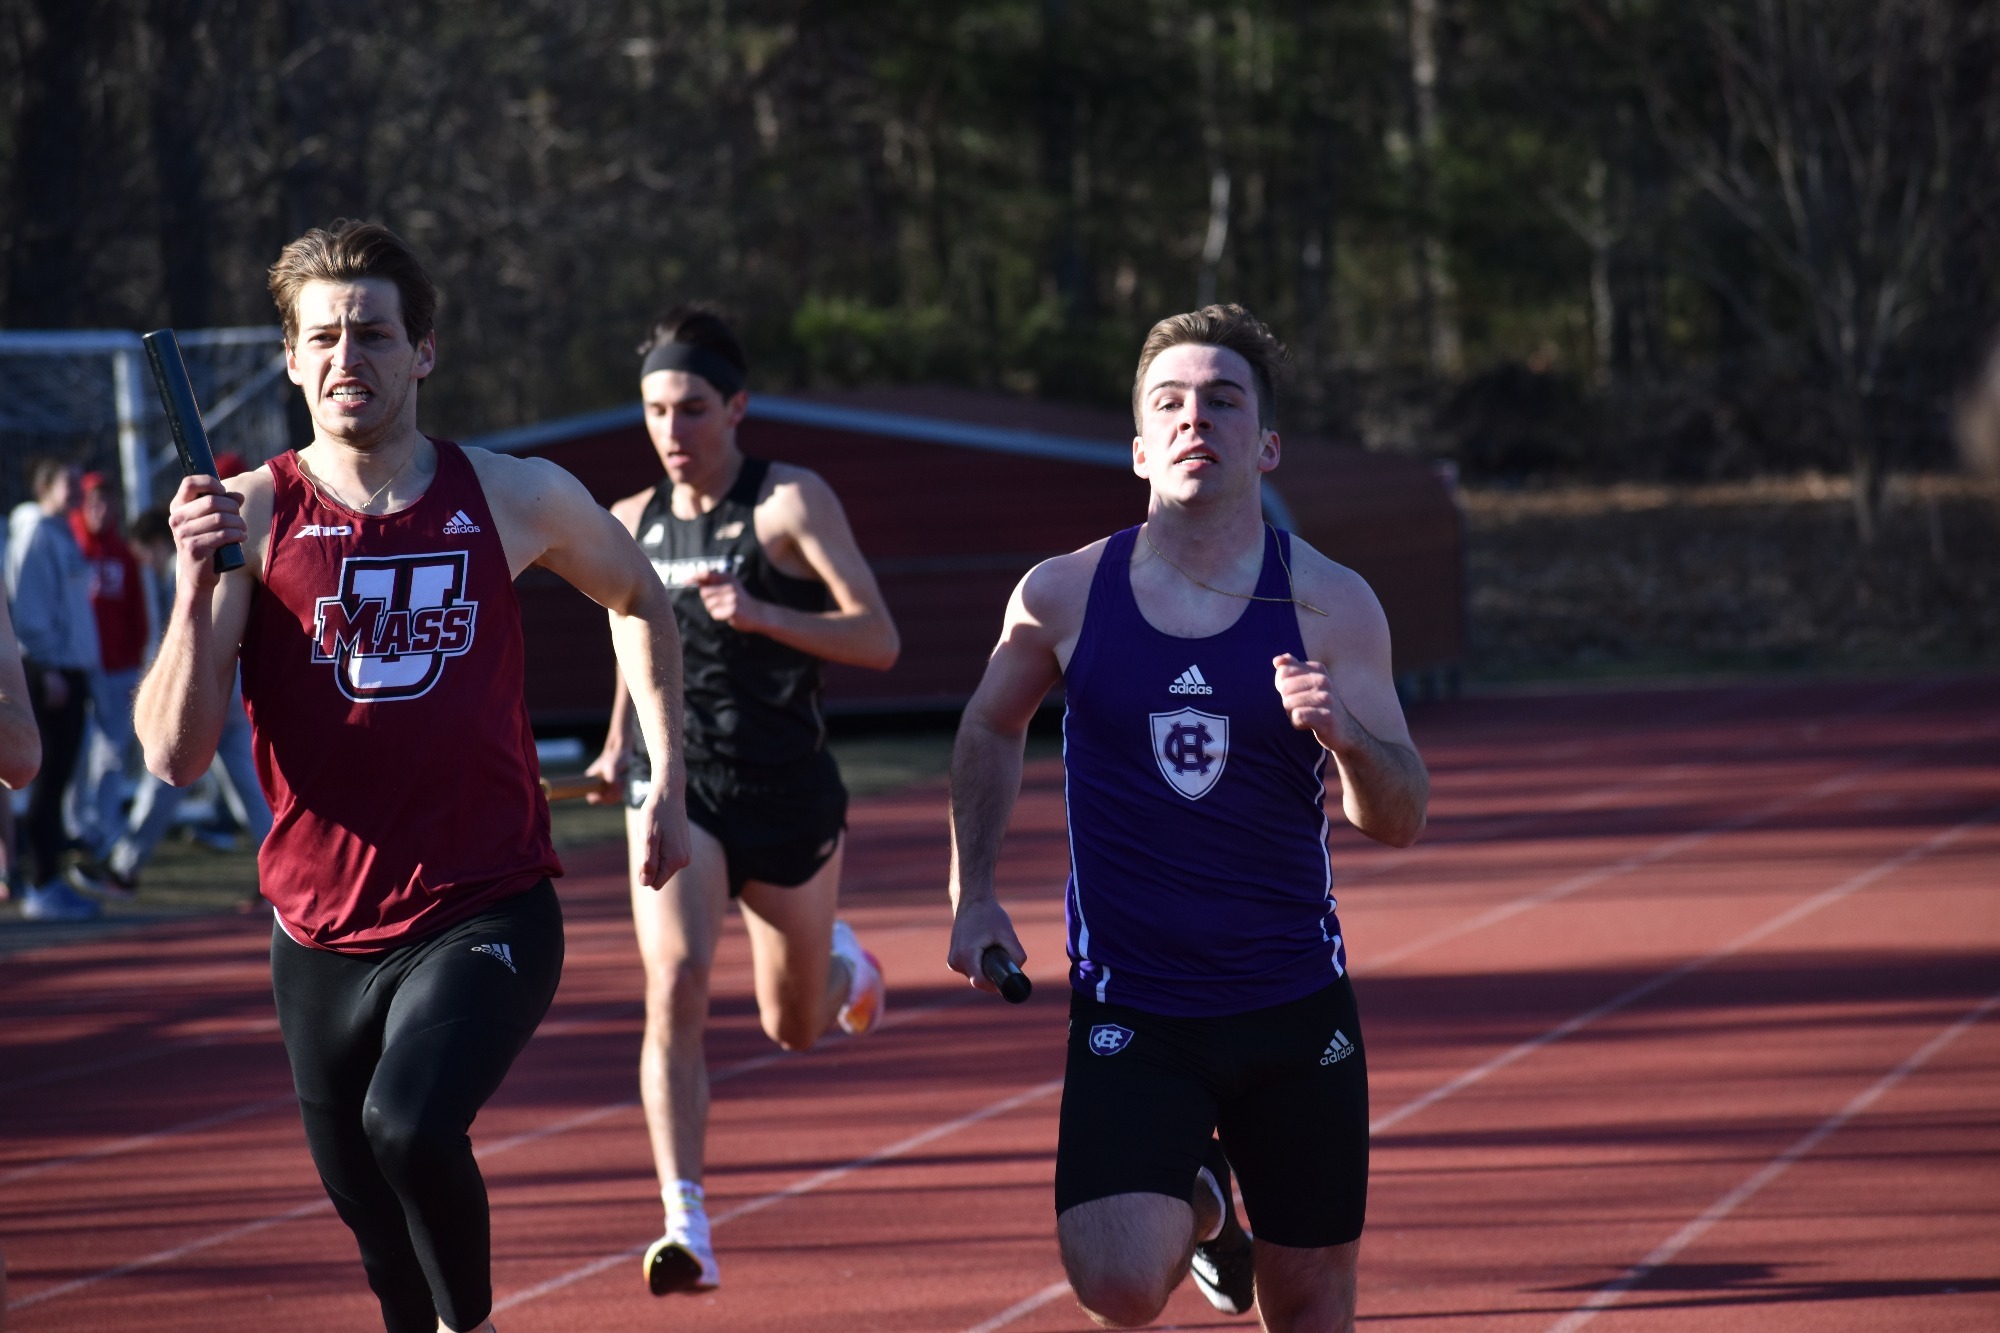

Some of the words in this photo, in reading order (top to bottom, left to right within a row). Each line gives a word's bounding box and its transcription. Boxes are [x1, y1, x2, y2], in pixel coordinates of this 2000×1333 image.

[294, 524, 352, 538] A10
[443, 524, 480, 535] adidas
[334, 550, 468, 703] U
[1169, 683, 1213, 695] adidas
[471, 946, 517, 973] adidas
[1319, 1043, 1355, 1066] adidas
